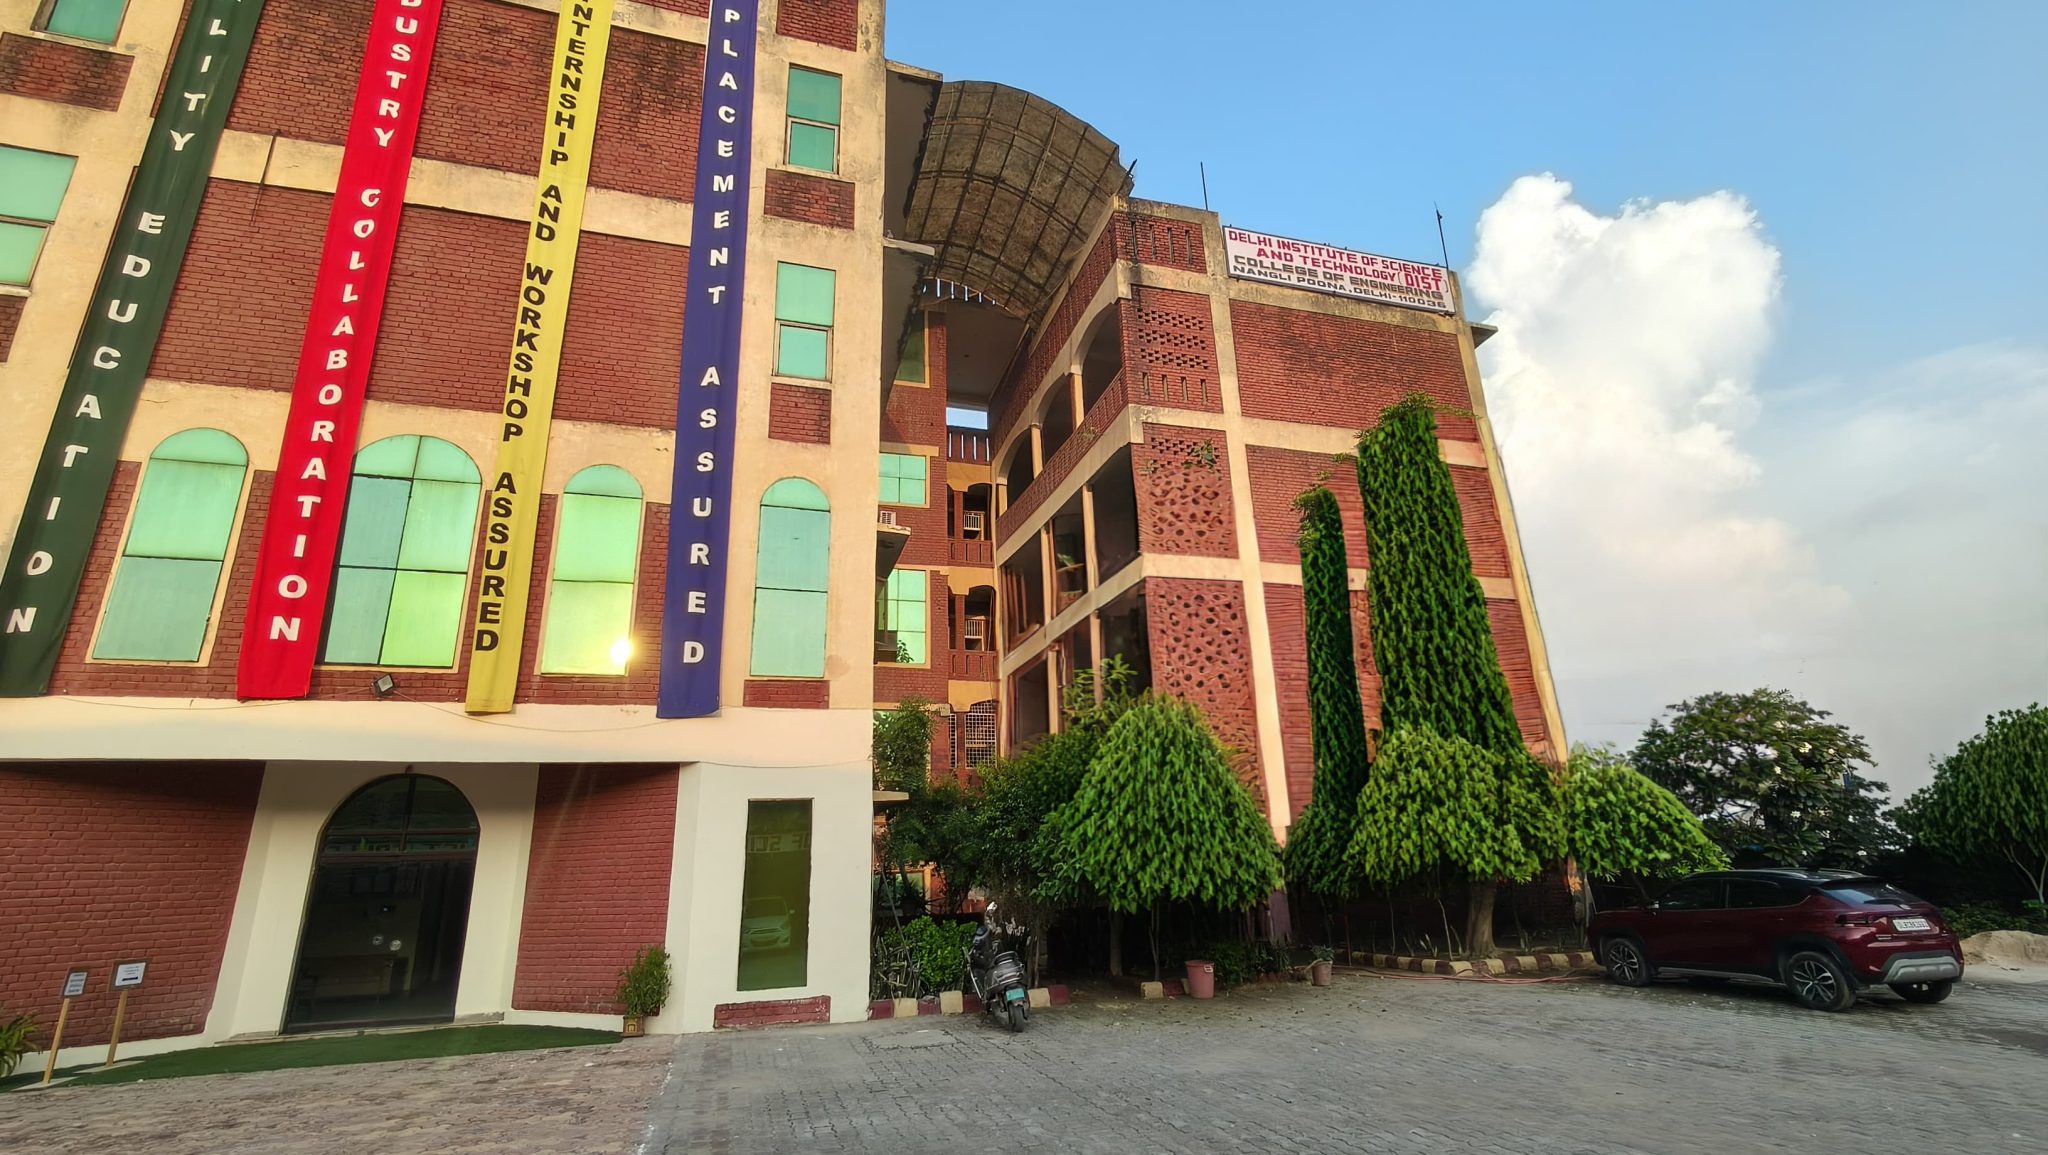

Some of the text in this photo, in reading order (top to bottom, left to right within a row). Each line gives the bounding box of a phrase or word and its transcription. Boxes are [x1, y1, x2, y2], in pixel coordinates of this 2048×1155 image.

[170, 0, 241, 152] LITY
[1229, 230, 1443, 279] DELHI INSTITUTE OF SCIENCE
[1233, 265, 1291, 282] NANGLI
[1234, 255, 1444, 300] COLLEGE OF ENGINEERING
[1256, 248, 1294, 263] AND
[1299, 255, 1396, 282] TECHNOLOGY
[475, 0, 593, 652] NTERNSHIP AND WORKSHOP ASSURED
[683, 8, 740, 664] PLACEMENT ASSURED
[269, 188, 382, 642] COLLABORATION
